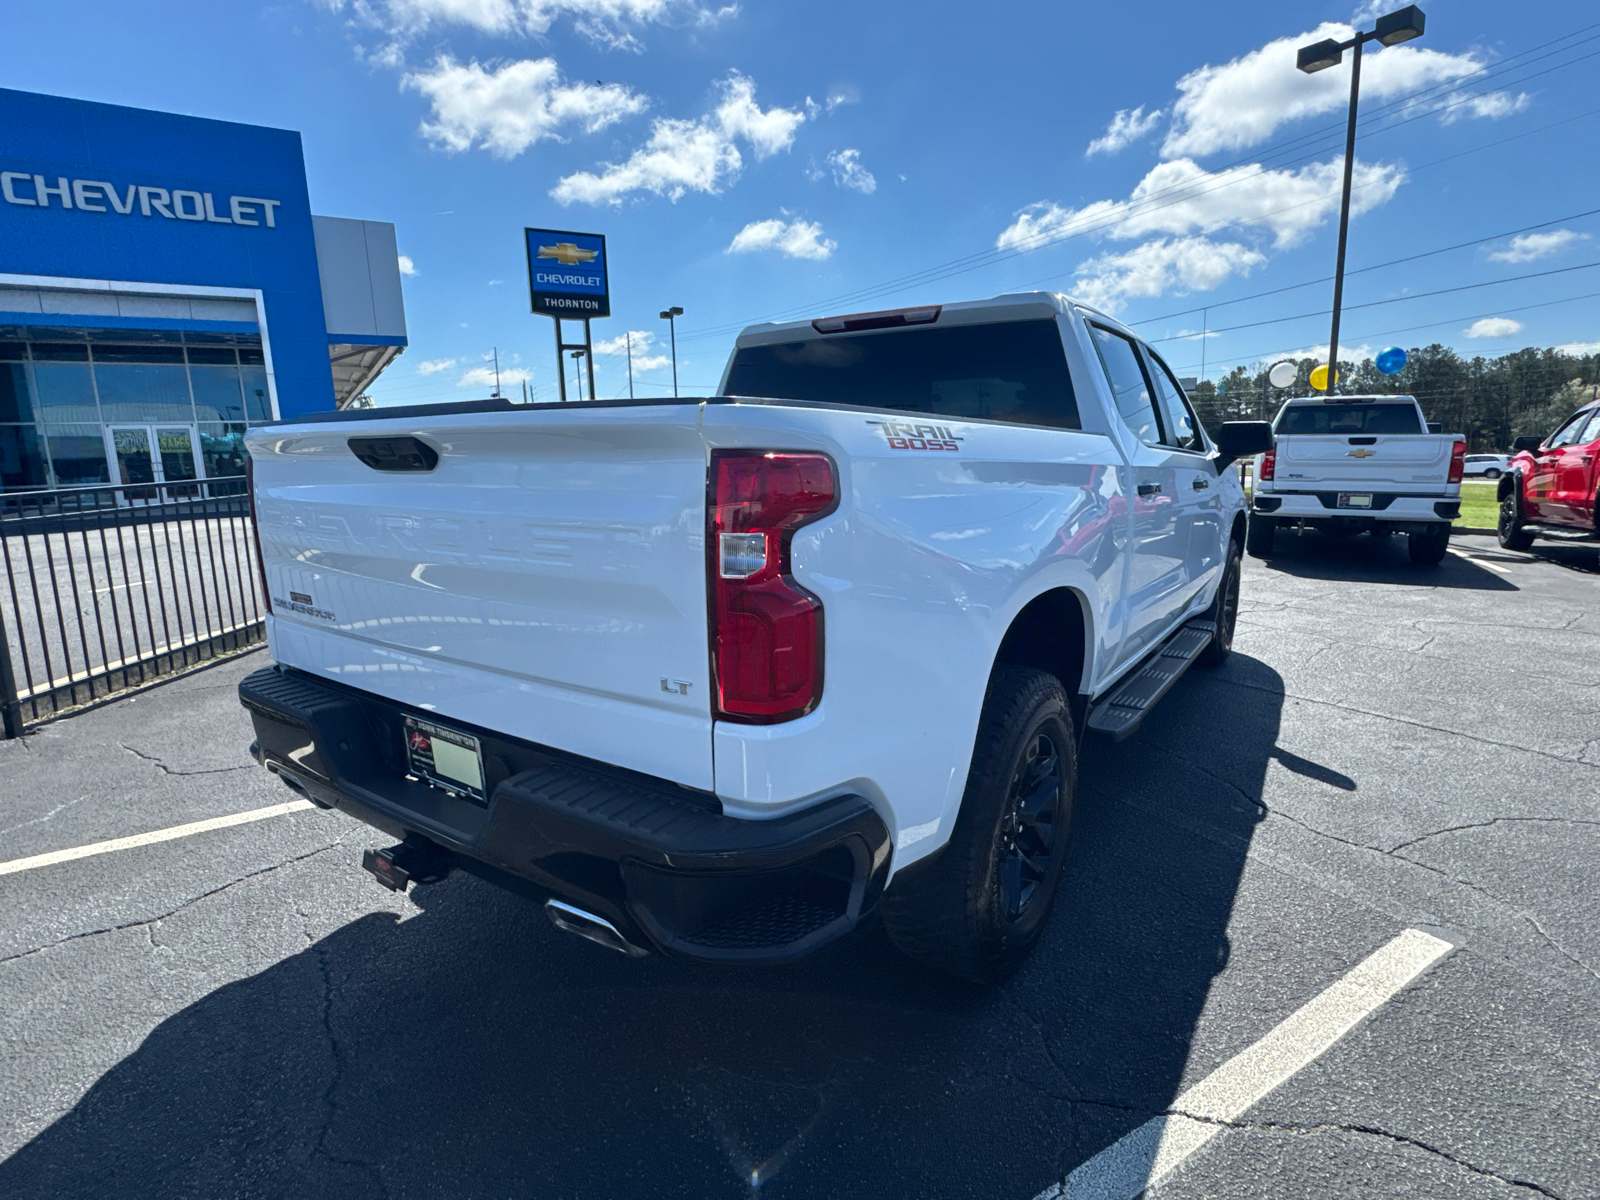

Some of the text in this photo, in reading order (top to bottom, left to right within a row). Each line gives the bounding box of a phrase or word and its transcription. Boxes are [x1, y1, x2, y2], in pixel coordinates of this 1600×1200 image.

[1, 171, 281, 228] CHEVROLET
[536, 273, 601, 286] CHEVROLET
[544, 298, 599, 309] THORNTON
[865, 420, 964, 441] TRAIL
[887, 437, 959, 451] BOSS
[660, 677, 693, 696] LT
